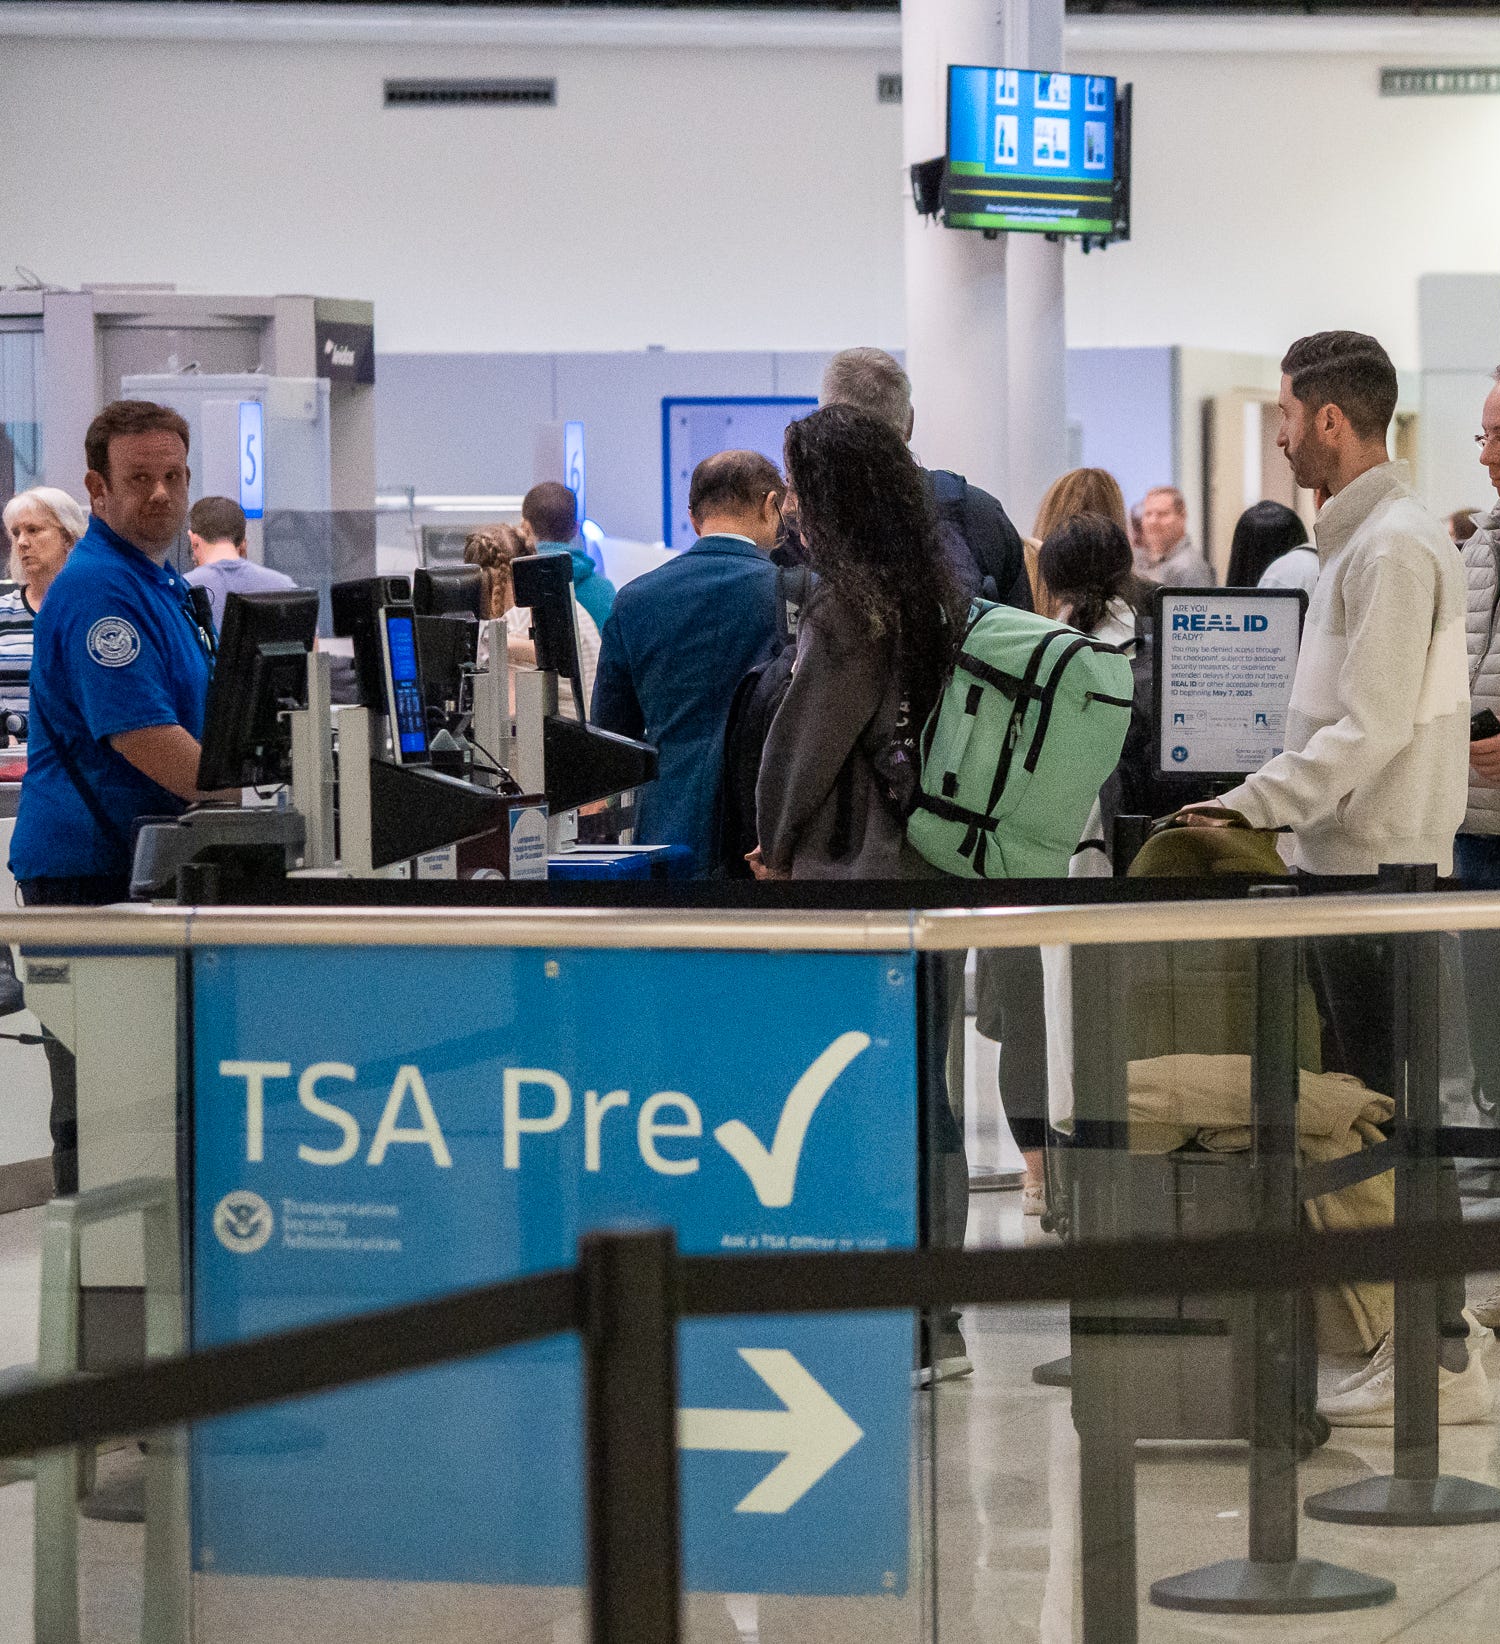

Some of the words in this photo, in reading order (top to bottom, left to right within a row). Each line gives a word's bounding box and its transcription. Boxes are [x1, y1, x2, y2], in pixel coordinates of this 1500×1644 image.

[245, 434, 256, 486] 5
[570, 450, 580, 494] 6
[1172, 604, 1189, 612] ARE
[1190, 604, 1208, 613] YOU
[1172, 614, 1240, 632] REAL
[1243, 614, 1268, 632] ID
[1172, 633, 1204, 641] READY?
[1171, 680, 1189, 688] REAL
[1189, 680, 1197, 688] ID
[218, 1060, 453, 1168] TSA
[503, 1067, 704, 1176] Pre
[281, 1198, 399, 1217] Transportation
[761, 1233, 787, 1249] TSA
